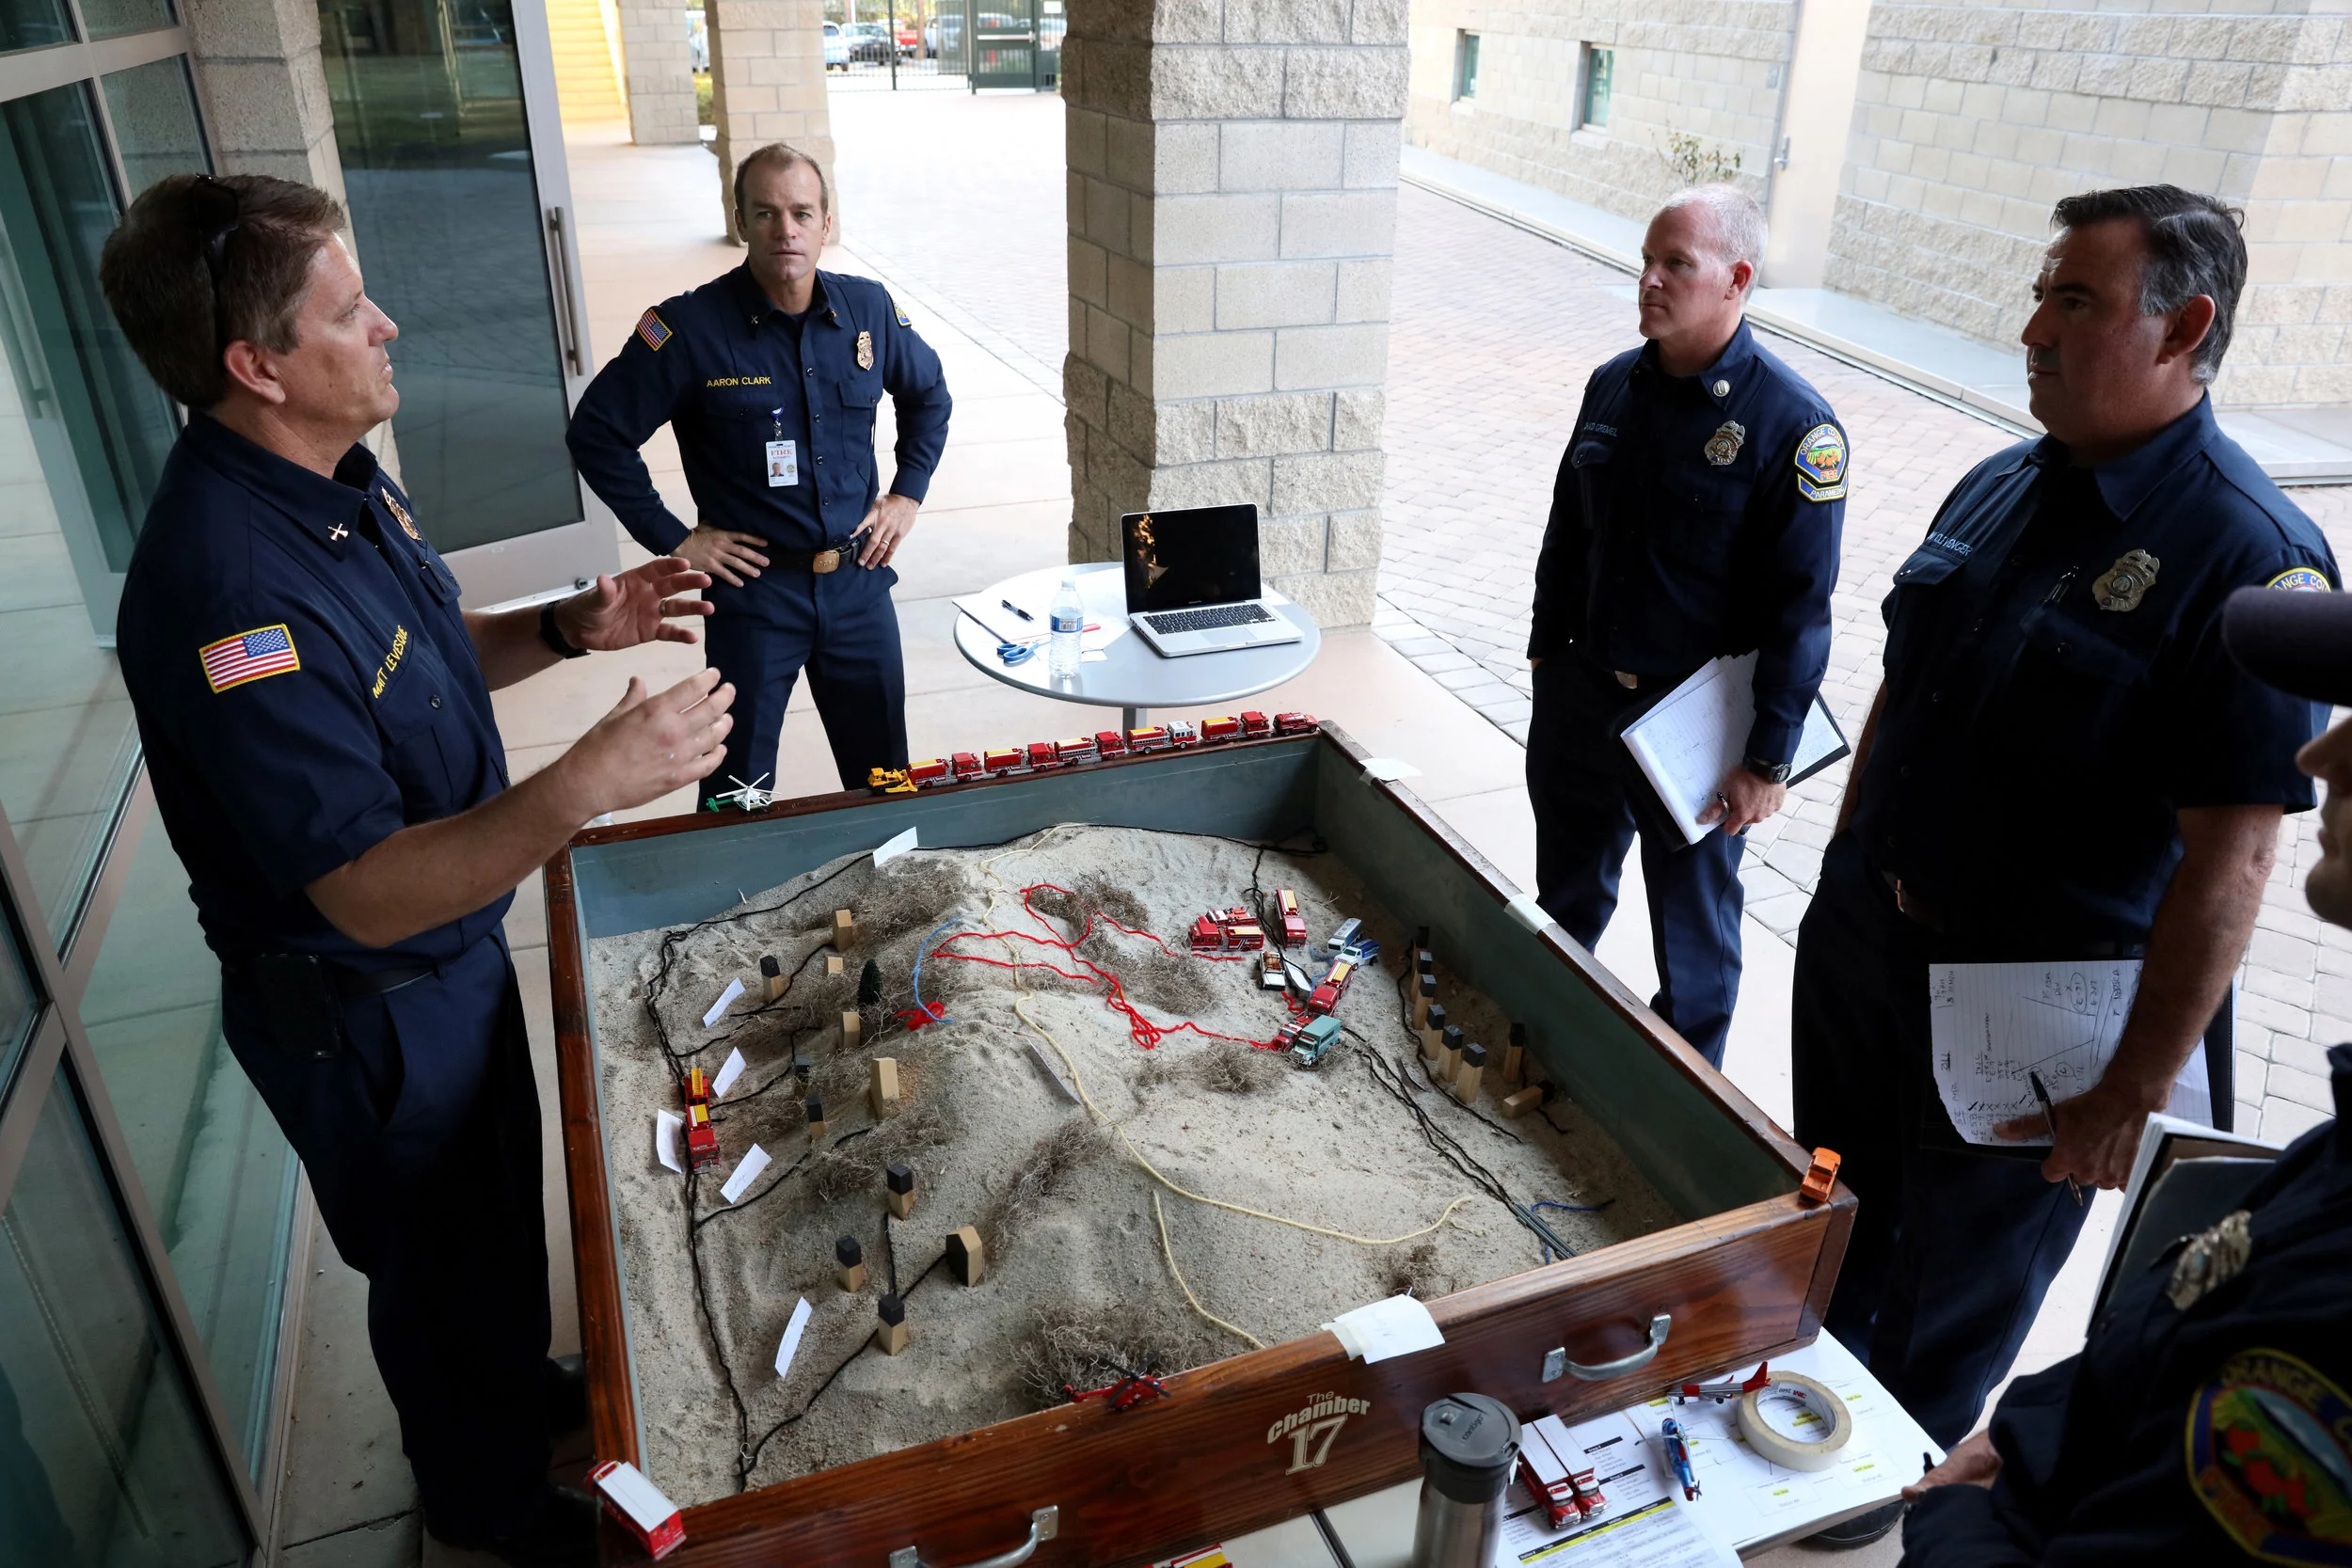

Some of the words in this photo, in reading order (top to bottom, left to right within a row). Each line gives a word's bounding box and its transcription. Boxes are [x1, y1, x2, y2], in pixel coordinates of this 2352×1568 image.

[707, 377, 739, 388] AARON
[741, 376, 771, 386] CLARK
[1800, 427, 1825, 456] ORANGE
[1820, 469, 1838, 481] FIRE
[2274, 573, 2306, 592] ANGE
[373, 667, 389, 699] MATT
[384, 625, 408, 673] LEVESQUE
[1306, 1391, 1334, 1405] The
[1792, 1389, 1807, 1400] 3M
[1285, 1413, 1348, 1476] 17
